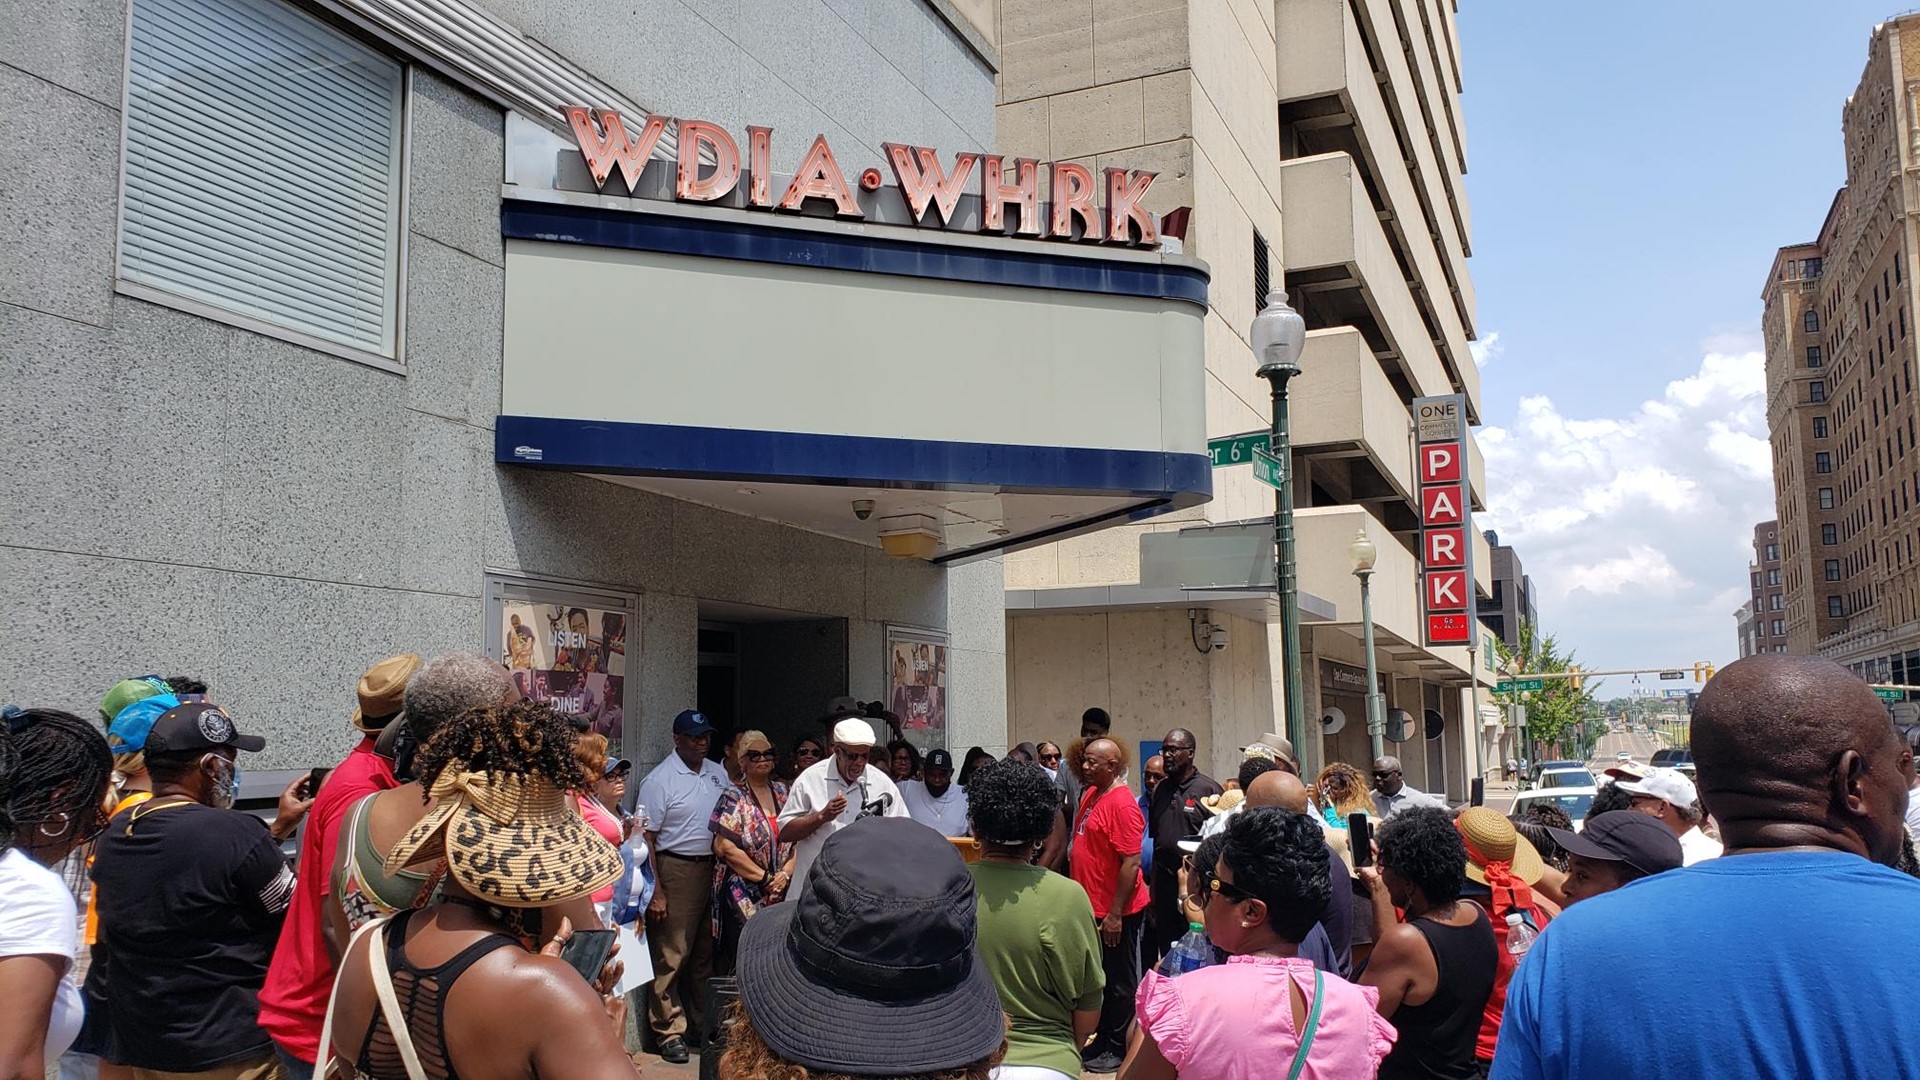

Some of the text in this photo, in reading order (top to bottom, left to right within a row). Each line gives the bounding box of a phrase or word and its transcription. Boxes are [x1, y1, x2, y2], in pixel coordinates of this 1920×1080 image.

[882, 142, 1162, 249] WHRK
[1420, 404, 1456, 417] ONE
[548, 630, 587, 649] LISTEN
[551, 696, 580, 713] DINE
